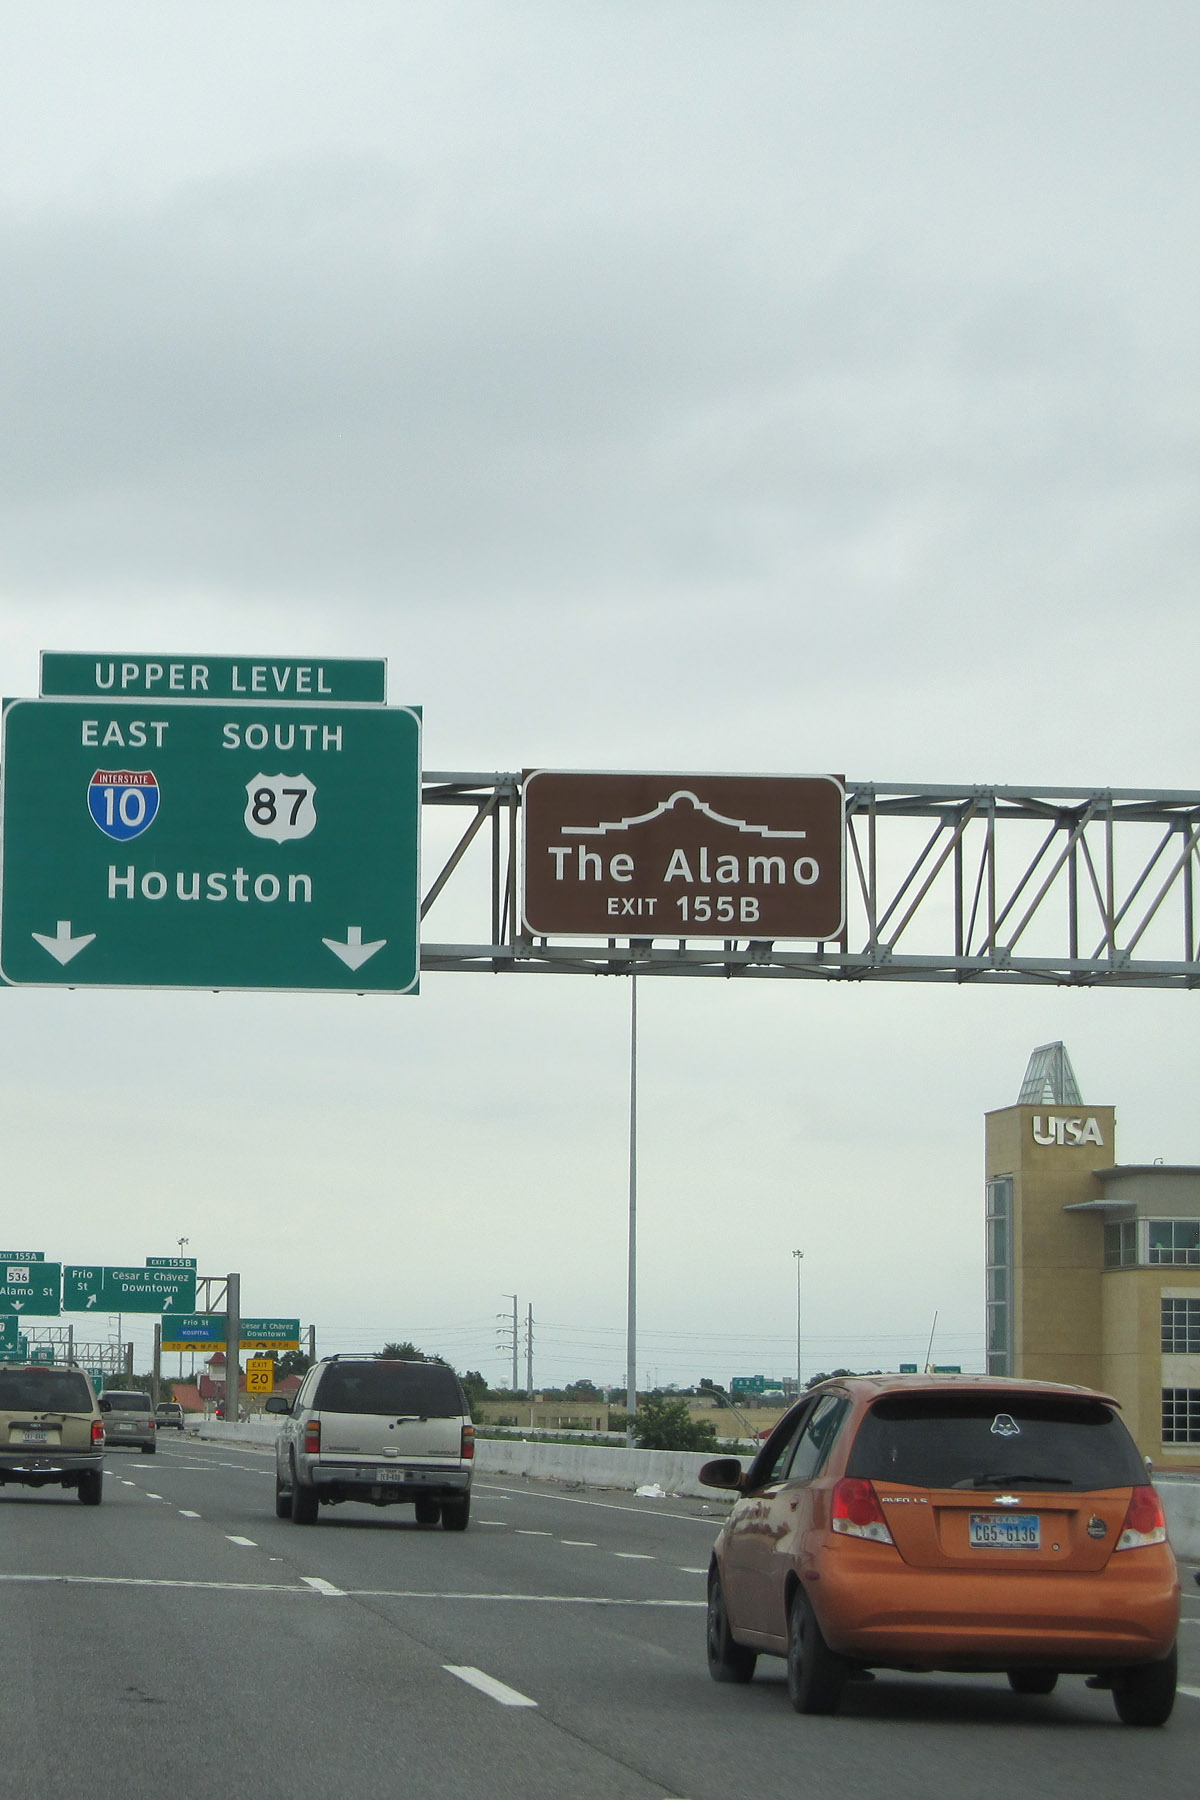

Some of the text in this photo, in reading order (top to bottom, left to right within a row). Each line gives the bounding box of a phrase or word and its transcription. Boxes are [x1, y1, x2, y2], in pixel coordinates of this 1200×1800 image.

[94, 663, 332, 693] UPPER LEVEL
[81, 720, 169, 747] EAST
[222, 723, 344, 751] SOUTH
[99, 773, 149, 785] INTERSTATE
[103, 787, 146, 827] 10
[251, 787, 308, 826] 87
[547, 845, 820, 886] The Alamo
[107, 865, 313, 903] Houston
[607, 895, 760, 923] EXIT 155B
[1032, 1115, 1104, 1146] UTSA
[15, 1252, 37, 1260] 155A
[168, 1258, 192, 1267] 155B
[8, 1272, 28, 1282] 536
[72, 1270, 93, 1279] Frio
[144, 1272, 150, 1280] E
[0, 1286, 34, 1296] Alamo
[42, 1287, 53, 1296] St
[77, 1282, 88, 1291] St
[121, 1283, 179, 1293] Downtown
[250, 1373, 269, 1384] 20
[989, 1516, 1019, 1524] TEXAS
